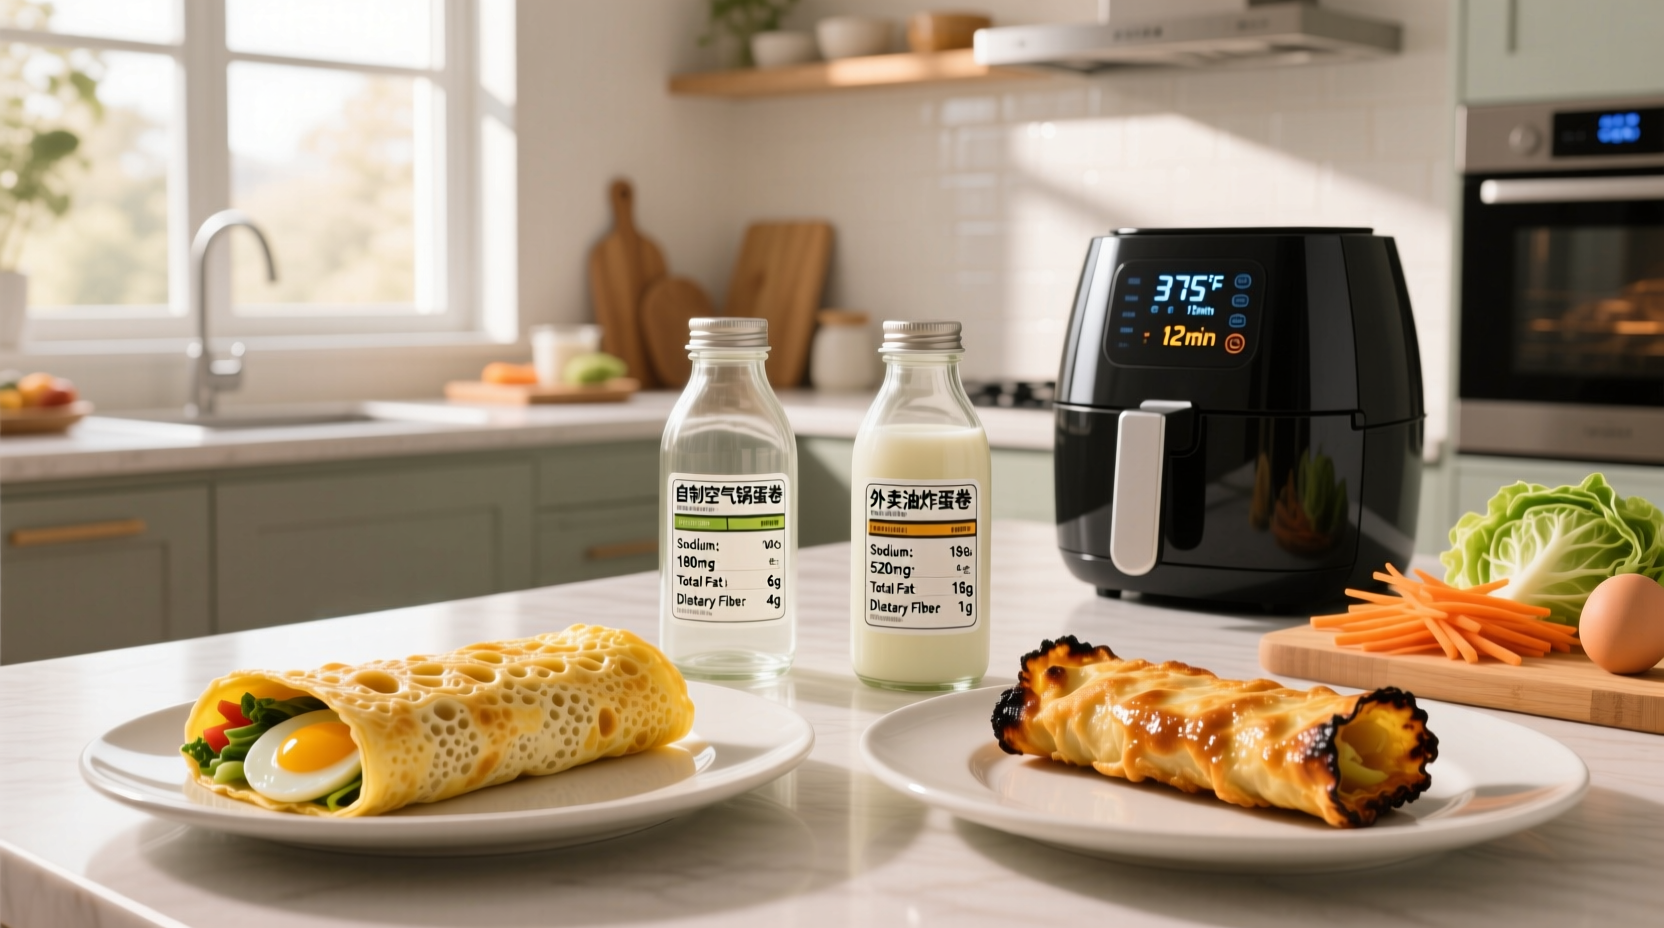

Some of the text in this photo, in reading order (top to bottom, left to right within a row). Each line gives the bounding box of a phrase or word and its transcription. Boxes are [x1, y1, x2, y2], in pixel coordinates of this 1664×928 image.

[1162, 325, 1216, 347] 12min
[676, 484, 783, 505] 自制空气锅蛋卷
[870, 488, 972, 511] 外卖油炸蛋卷
[677, 555, 716, 572] 180mg
[676, 574, 703, 588] Total
[767, 574, 781, 590] 6g
[869, 581, 894, 594] Total
[766, 594, 781, 609] 4g
[958, 601, 973, 616] 1g
